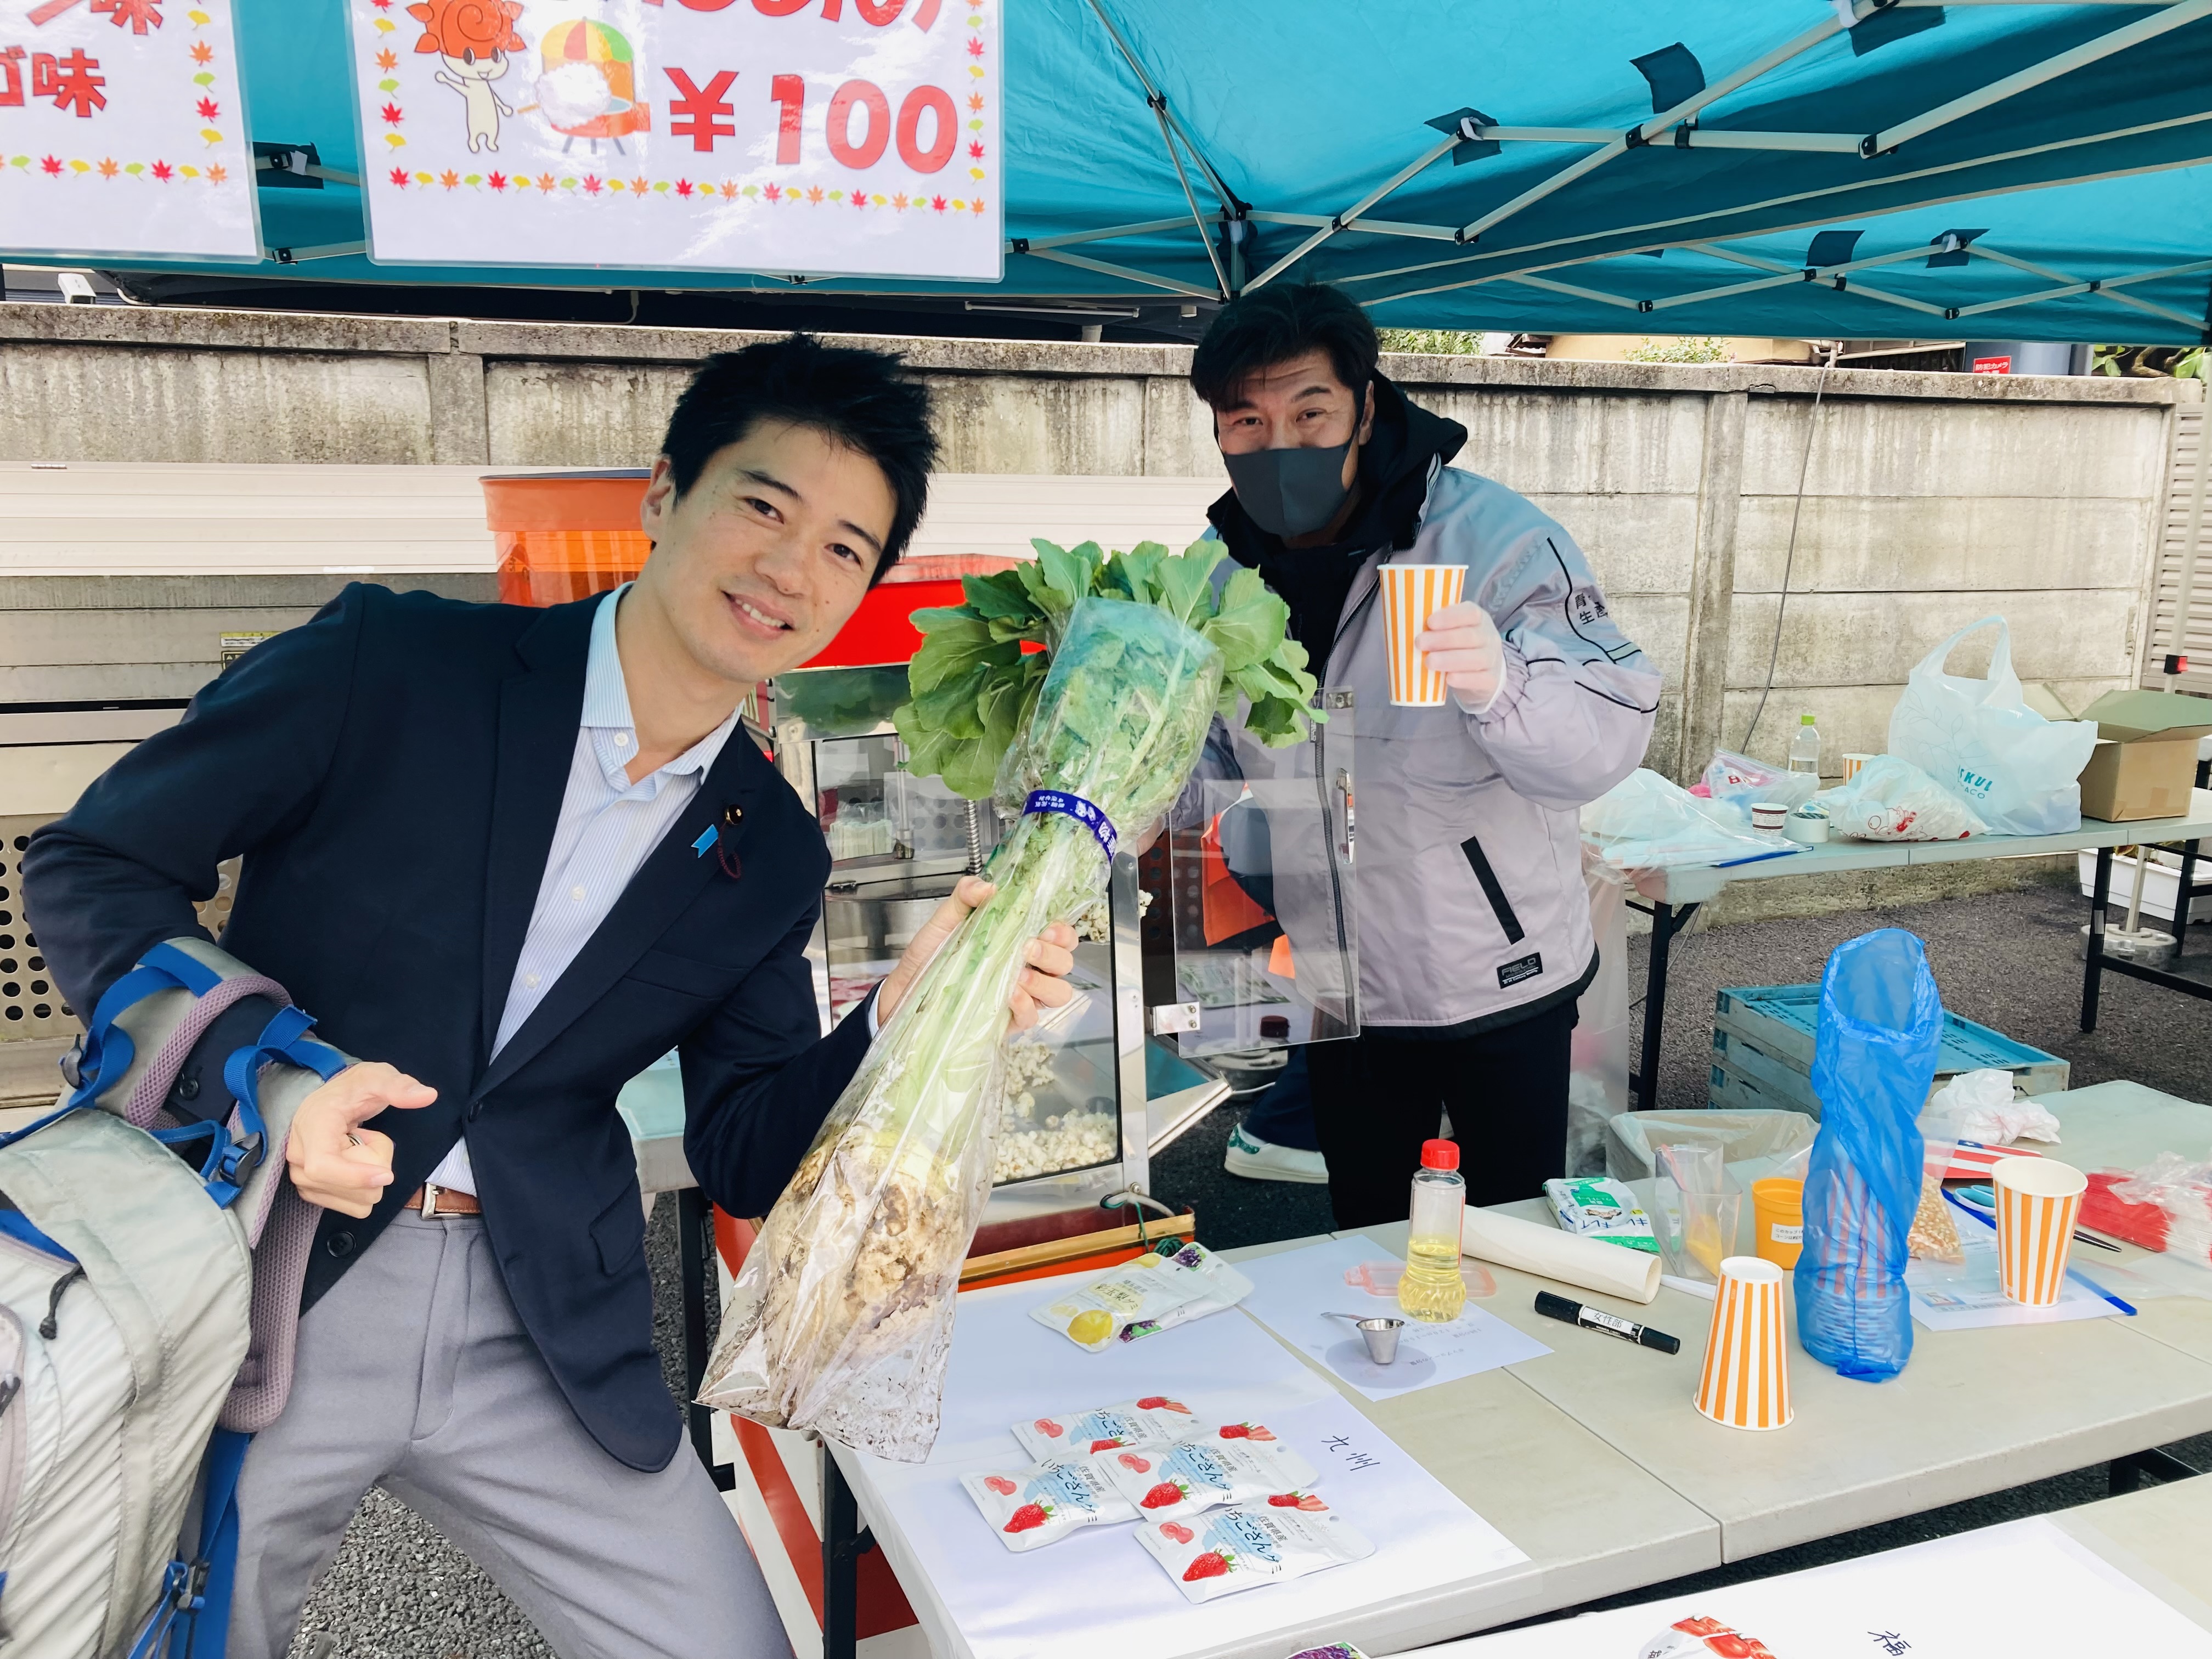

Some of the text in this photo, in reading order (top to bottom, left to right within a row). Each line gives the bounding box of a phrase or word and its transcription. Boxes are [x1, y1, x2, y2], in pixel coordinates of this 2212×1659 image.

[1976, 362, 2008, 371] 防犯カメラ
[1592, 1312, 1624, 1328] 女性部
[1210, 1449, 1238, 1472] 佐賀県産
[1321, 1435, 1380, 1471] 九州
[1041, 1459, 1097, 1523] いちごさんグミ
[1079, 1466, 1106, 1492] 佐賀県産
[1257, 1516, 1288, 1542] 佐賀県産
